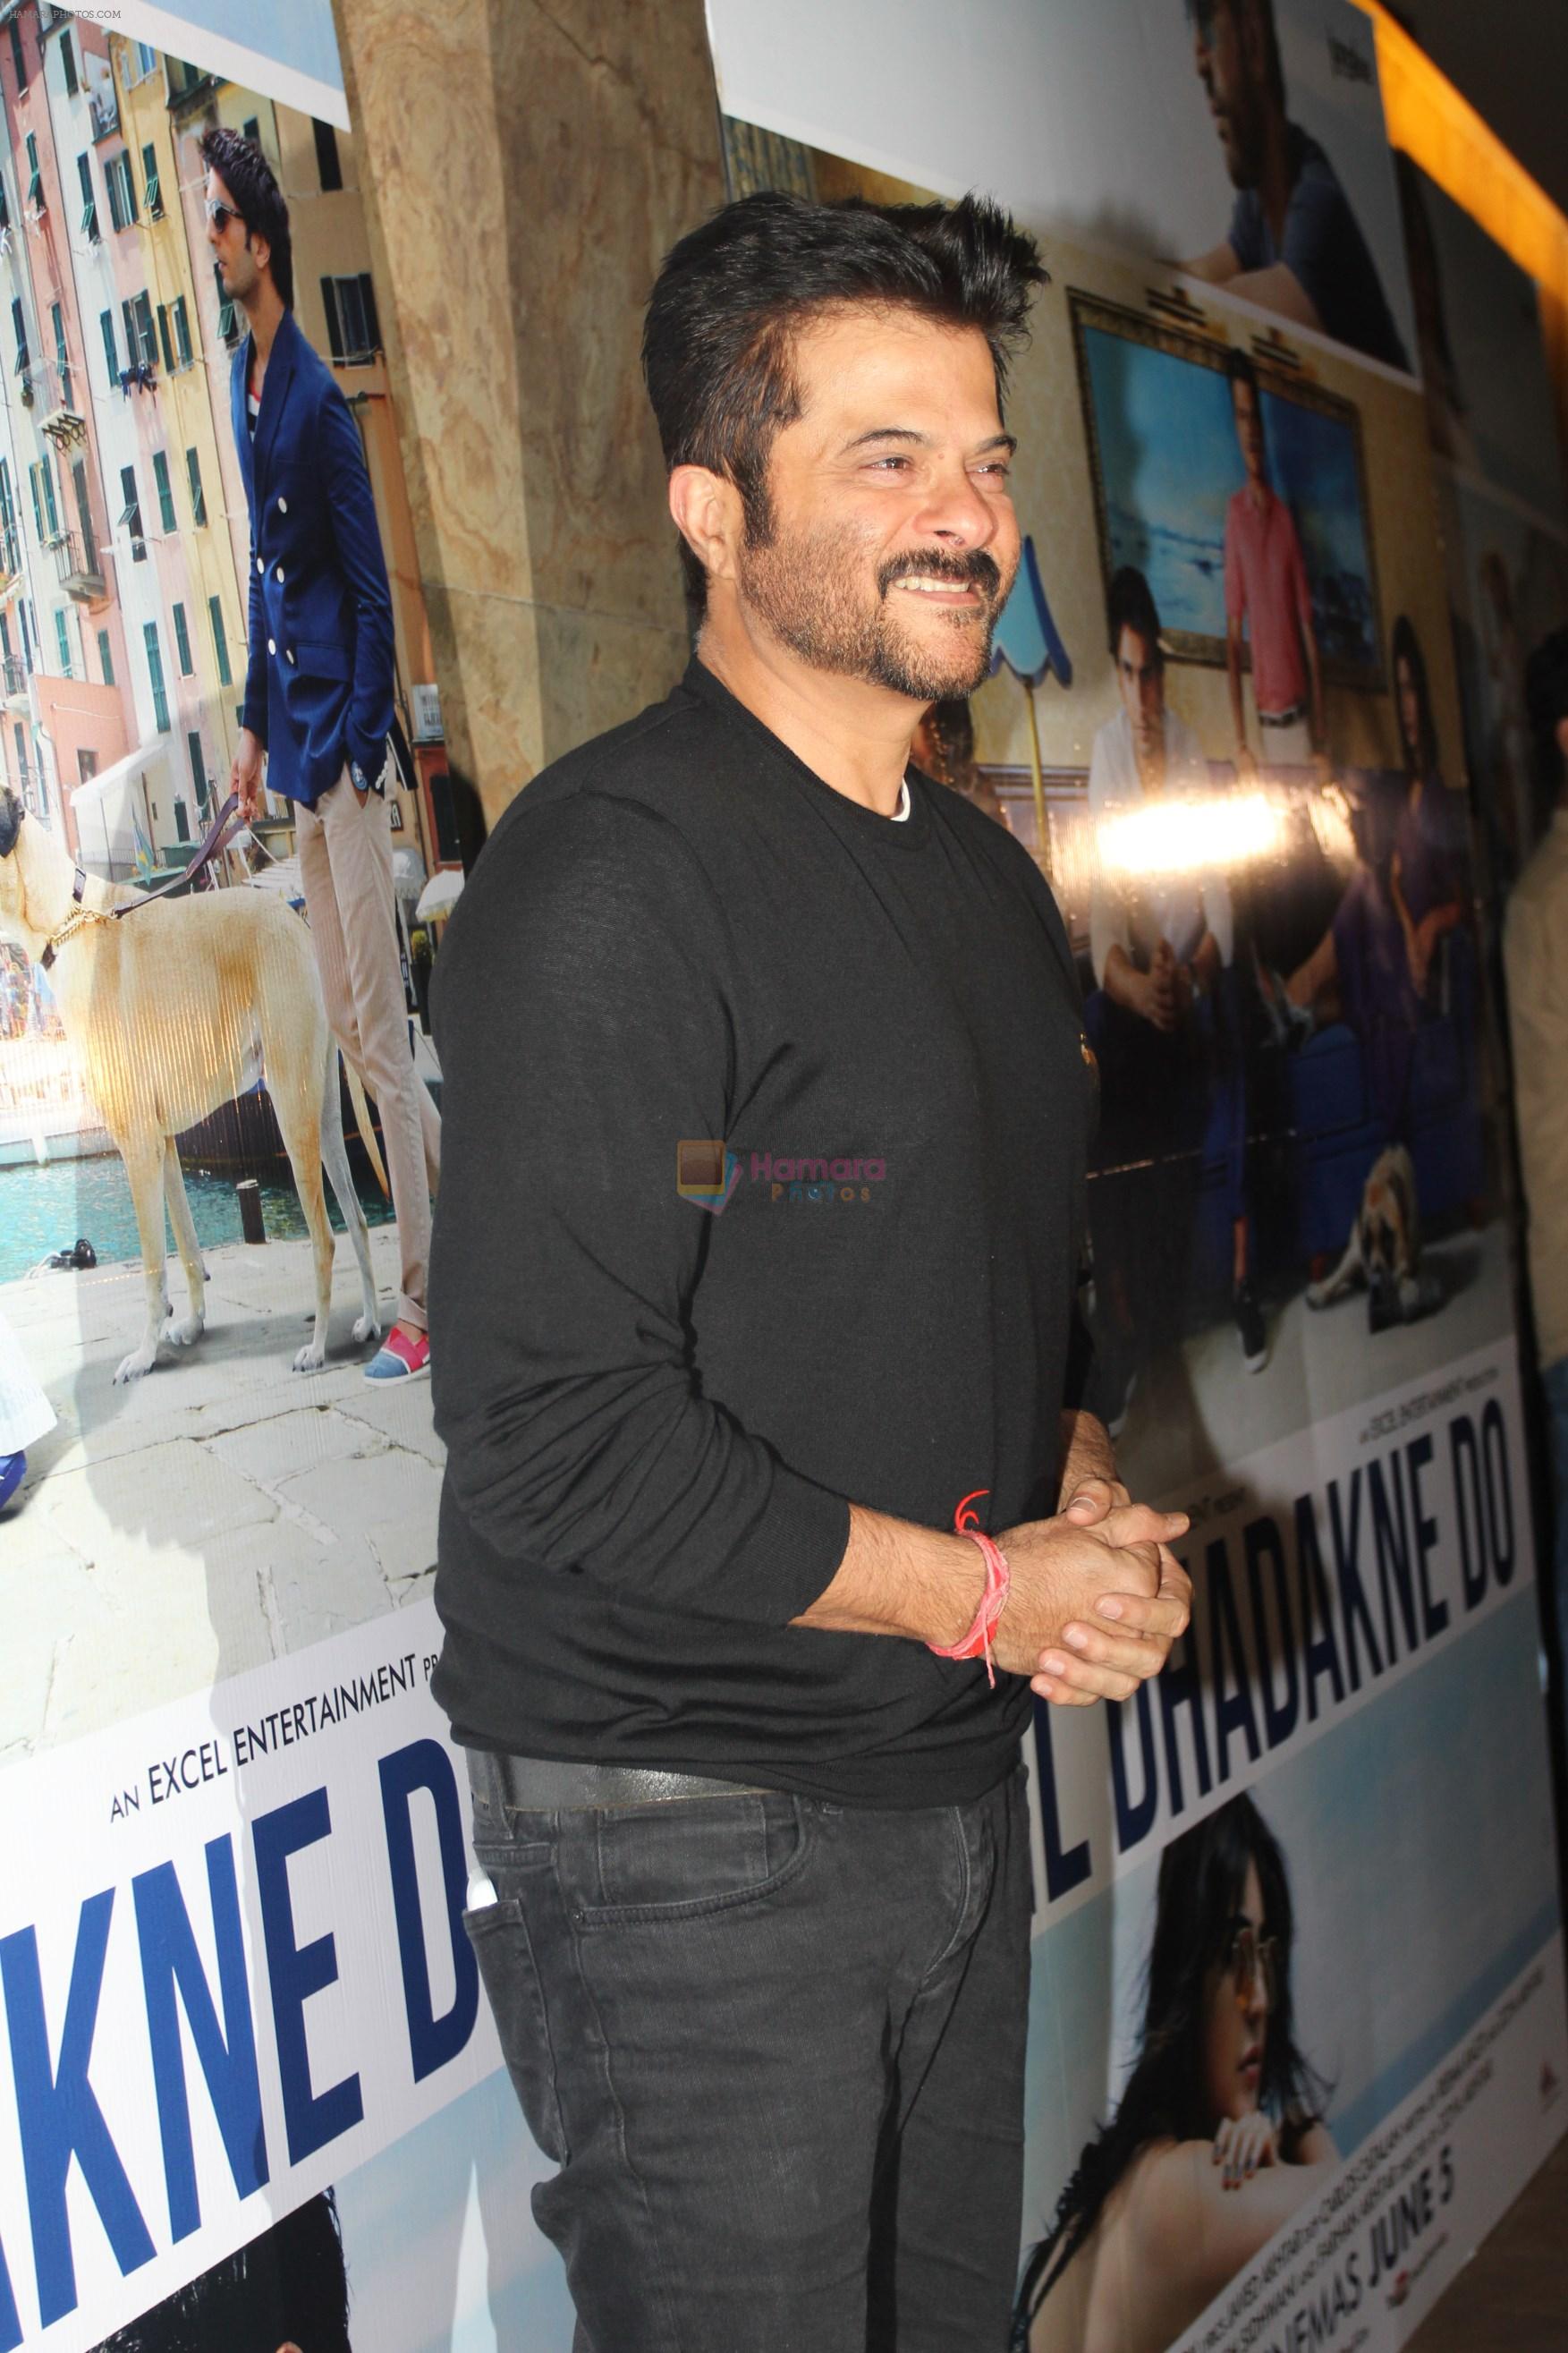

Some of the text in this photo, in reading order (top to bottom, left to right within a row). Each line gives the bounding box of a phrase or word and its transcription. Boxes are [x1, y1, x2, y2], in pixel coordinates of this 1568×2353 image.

[110, 1785, 140, 1823] AN
[148, 1740, 228, 1805] EXCEL
[233, 1653, 416, 1767] ENTERTAINMENT
[1105, 1432, 1450, 1855] DHADAKNE
[1449, 1397, 1514, 1612] DO
[0, 1785, 363, 2353] KNE
[1368, 2165, 1434, 2289] JUNE
